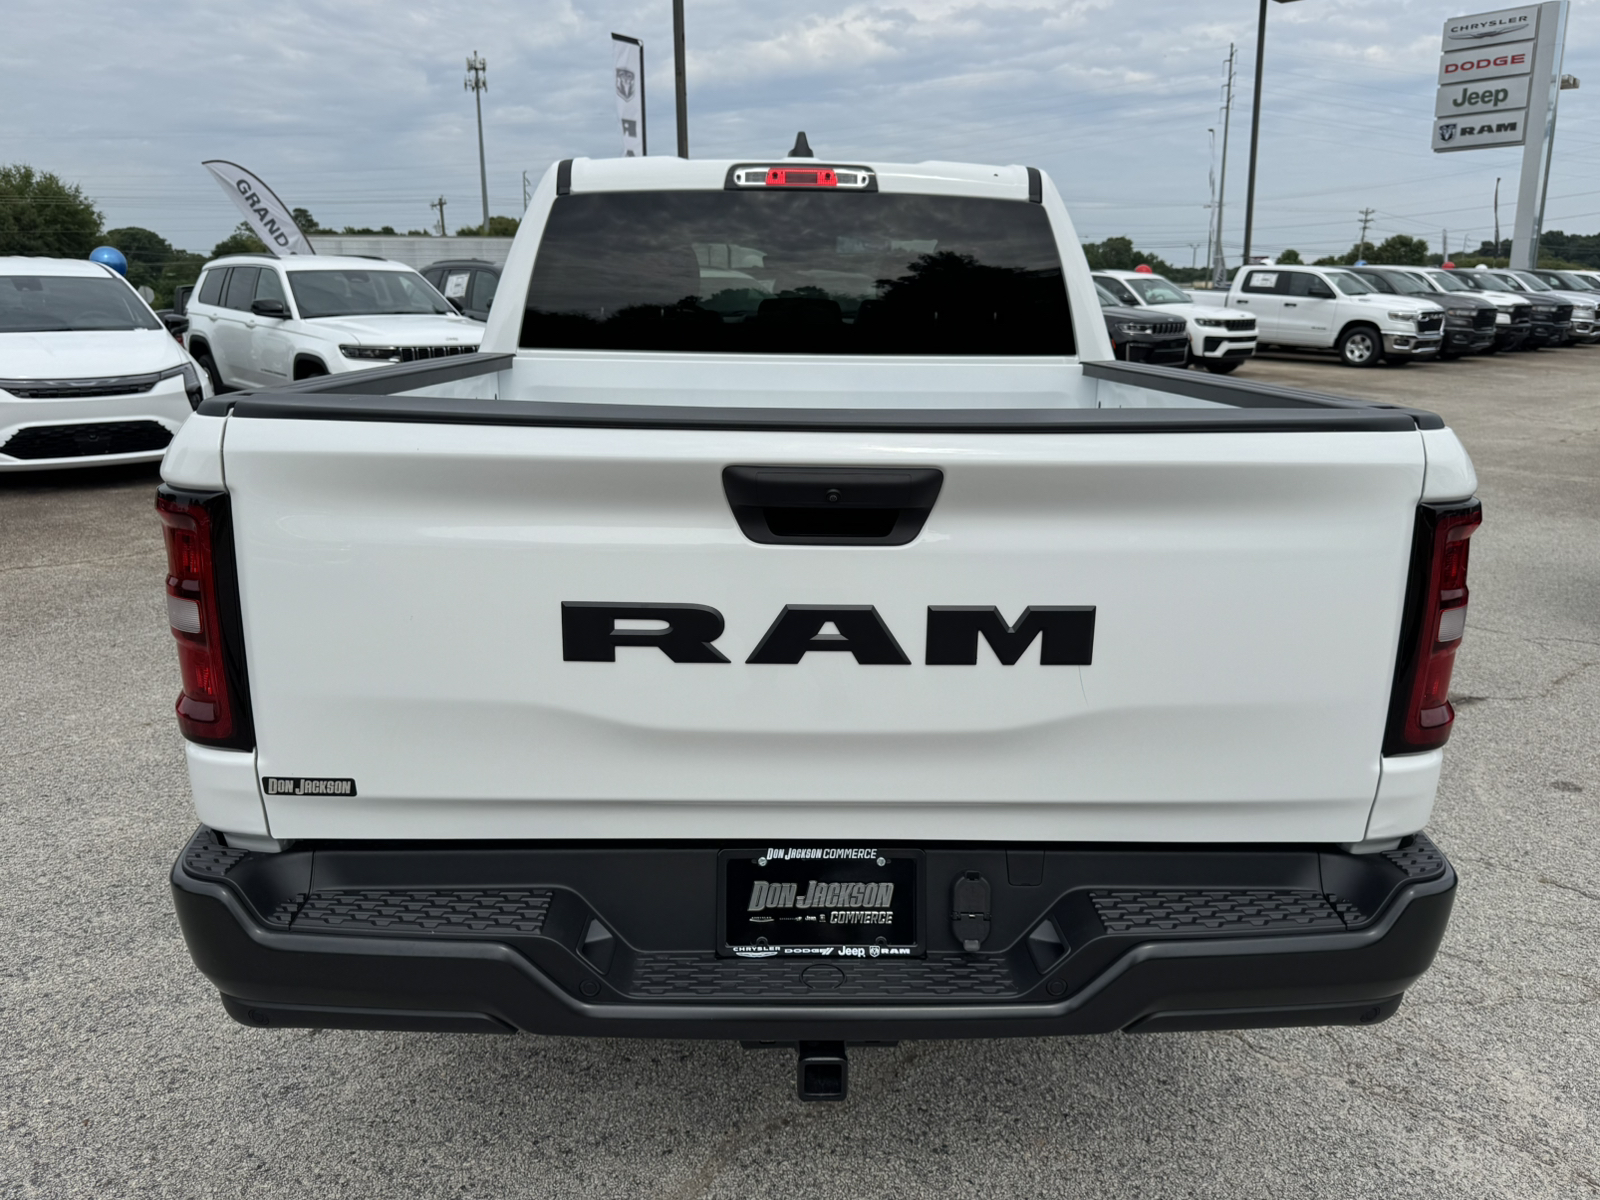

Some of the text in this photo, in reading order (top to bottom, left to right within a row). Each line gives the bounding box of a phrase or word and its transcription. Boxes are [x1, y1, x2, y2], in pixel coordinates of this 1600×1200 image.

[1450, 15, 1528, 33] CHRYSLER
[1444, 54, 1526, 74] DODGE
[1452, 87, 1509, 108] Jeep
[1459, 122, 1518, 137] RAM
[236, 179, 289, 247] GRAND
[561, 601, 1097, 665] RAM
[822, 848, 878, 859] COMMERCE
[829, 911, 894, 925] COMMERCE
[838, 945, 866, 958] Jeep
